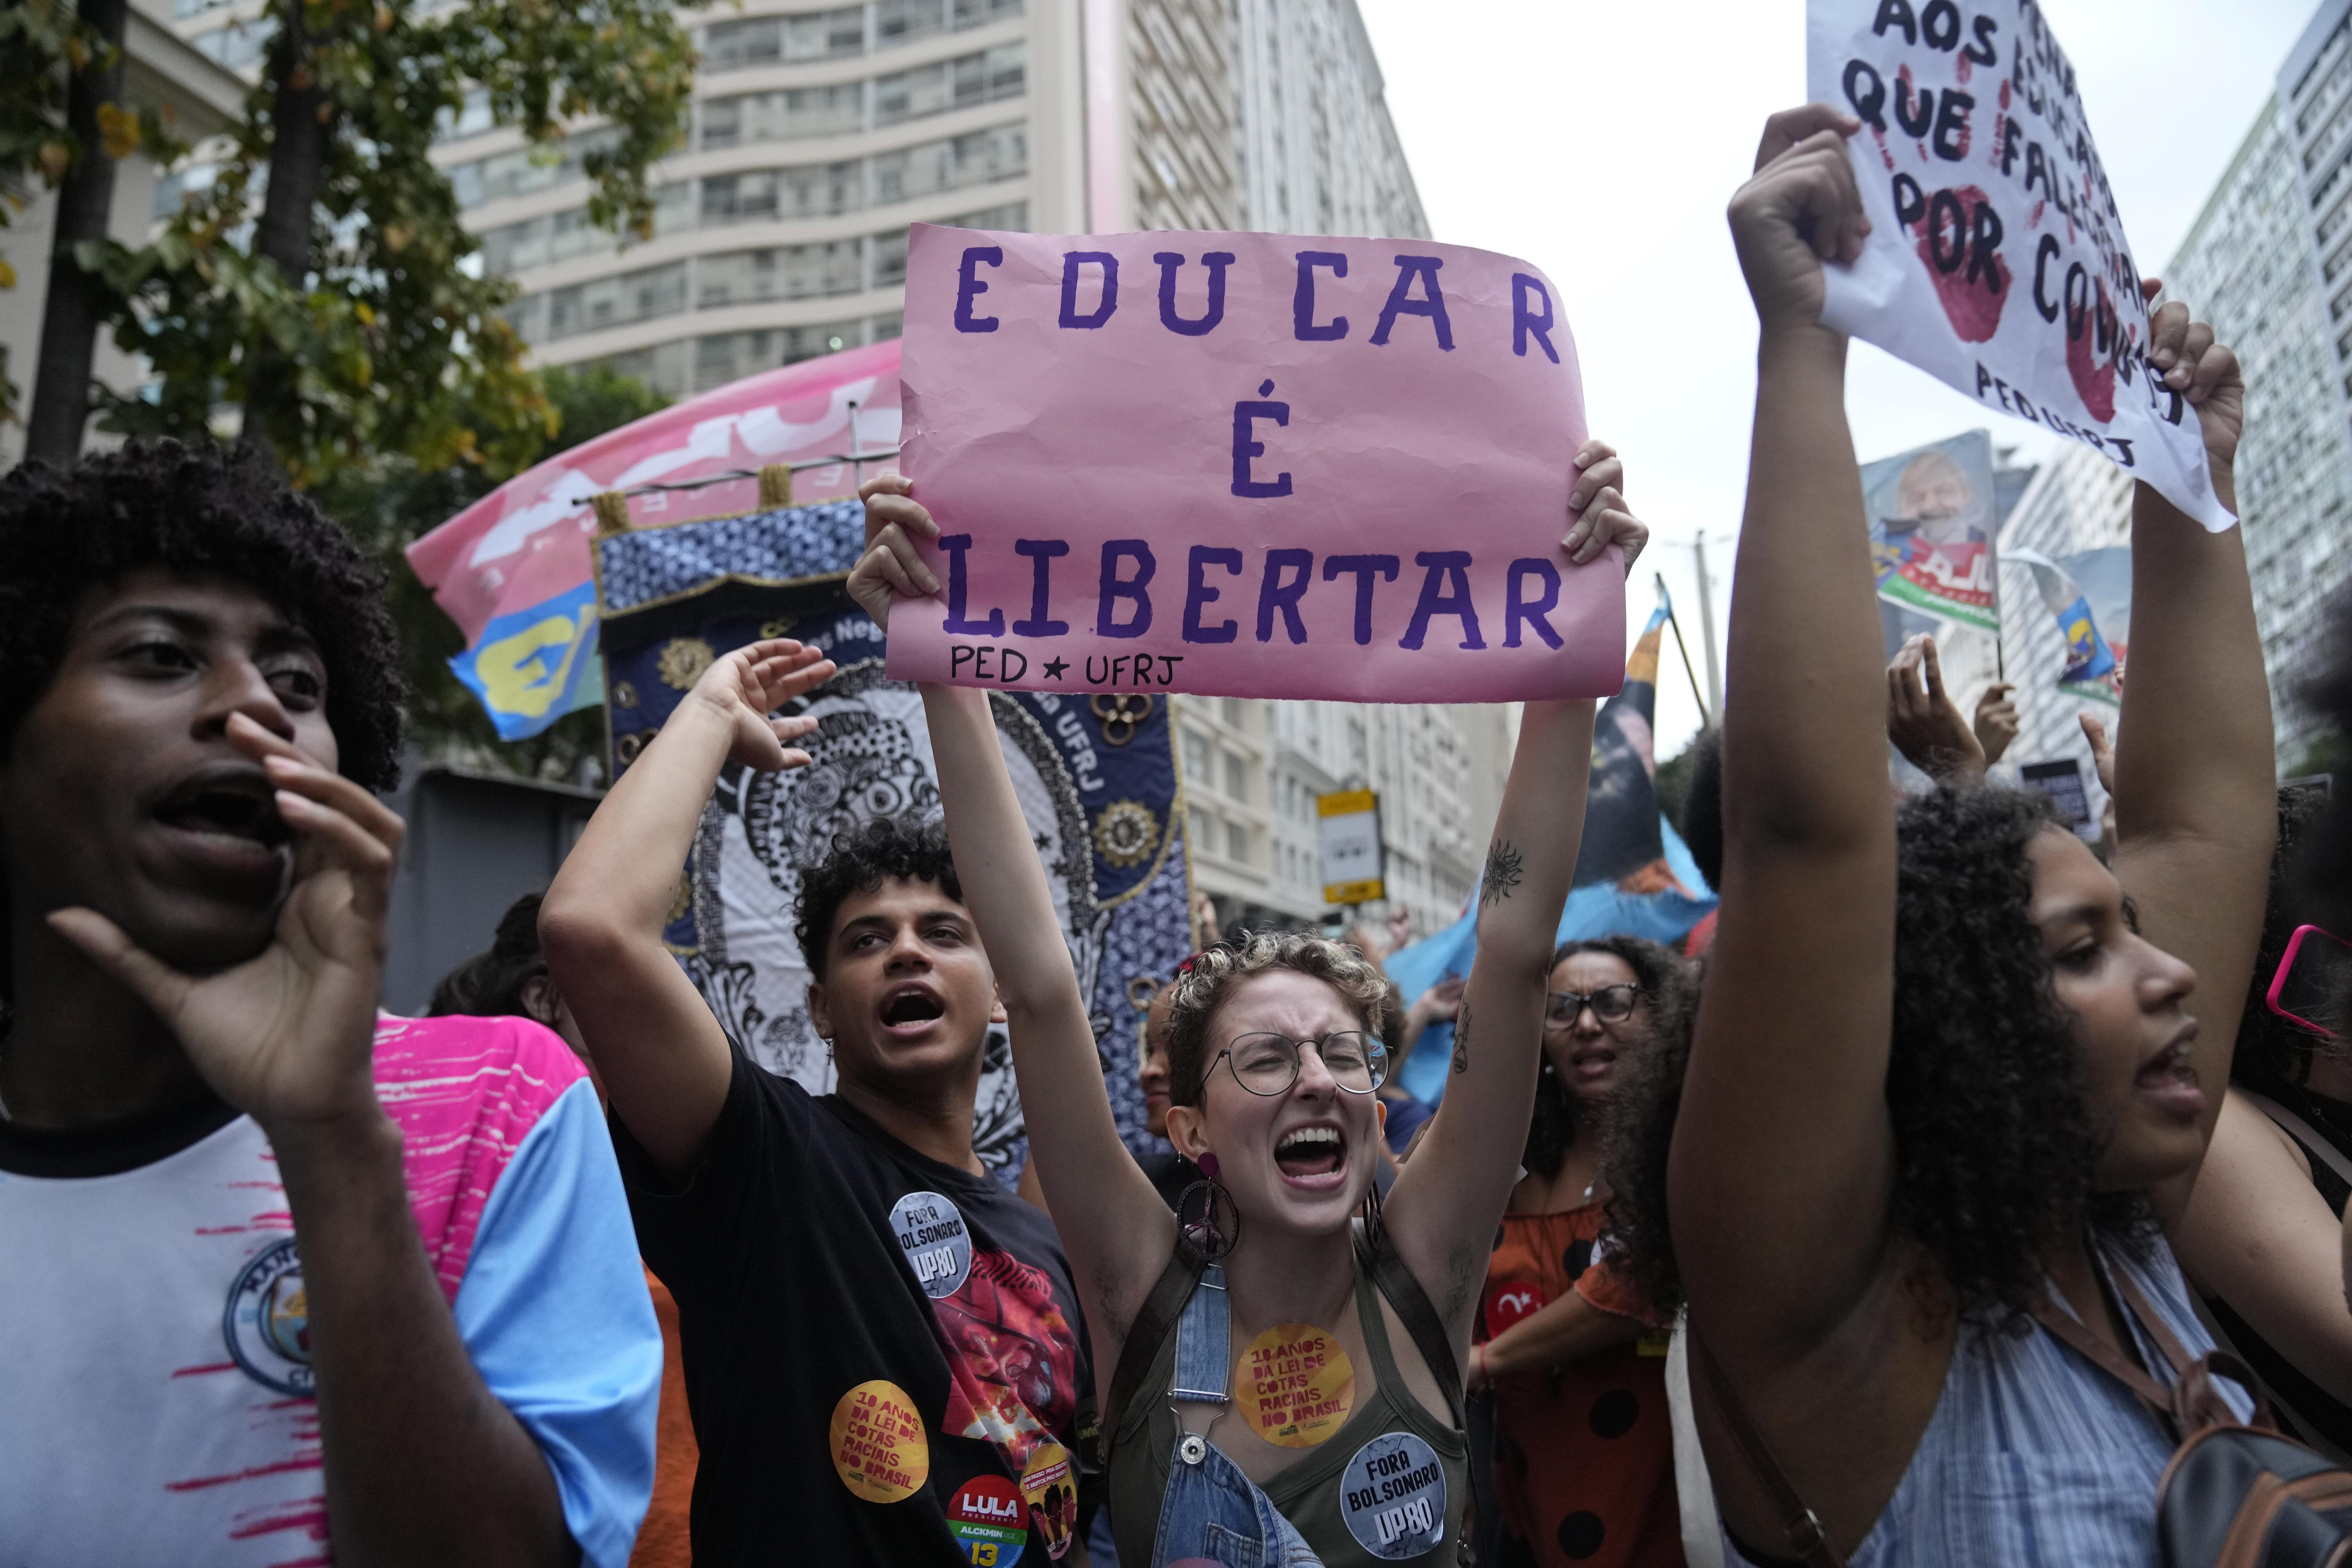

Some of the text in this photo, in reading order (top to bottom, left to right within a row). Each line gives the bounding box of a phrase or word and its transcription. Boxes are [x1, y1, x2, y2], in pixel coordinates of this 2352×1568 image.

[1872, 0, 1998, 67] AOS
[1842, 59, 1975, 162] QUE
[1891, 172, 2003, 296] POR
[954, 246, 1560, 364] EDUCAR
[1976, 360, 2039, 422] PED
[1231, 379, 1293, 498] É
[938, 534, 1564, 650] LIBERTAR
[951, 646, 1184, 686] PED UFRJ
[1056, 710, 1105, 791] UFRJ
[905, 1206, 939, 1227] FORA
[898, 1220, 962, 1250] OLSONARO
[1250, 1338, 1325, 1364] 10 ANOS
[1254, 1354, 1325, 1379] DA LEI DE
[1256, 1374, 1308, 1395] COTAS
[1259, 1388, 1322, 1411] RACIAIS
[851, 1406, 915, 1442] DA LEI DE
[856, 1392, 919, 1431] 10 ANOS
[1261, 1412, 1288, 1428] NO
[1292, 1399, 1347, 1422] BRASIL
[848, 1421, 897, 1448] COTAS
[843, 1435, 901, 1467] RACIAIS
[1366, 1450, 1411, 1481] FORA
[840, 1449, 862, 1468] NO
[864, 1461, 914, 1490] BRASIL
[1031, 1471, 1045, 1480] PASSO
[1347, 1462, 1439, 1512] BOLSONARO
[962, 1493, 1018, 1518] LULA
[962, 1512, 1018, 1524] PRESIDENTE
[960, 1526, 1003, 1538] ALCKMIN
[971, 1541, 998, 1567] 13
